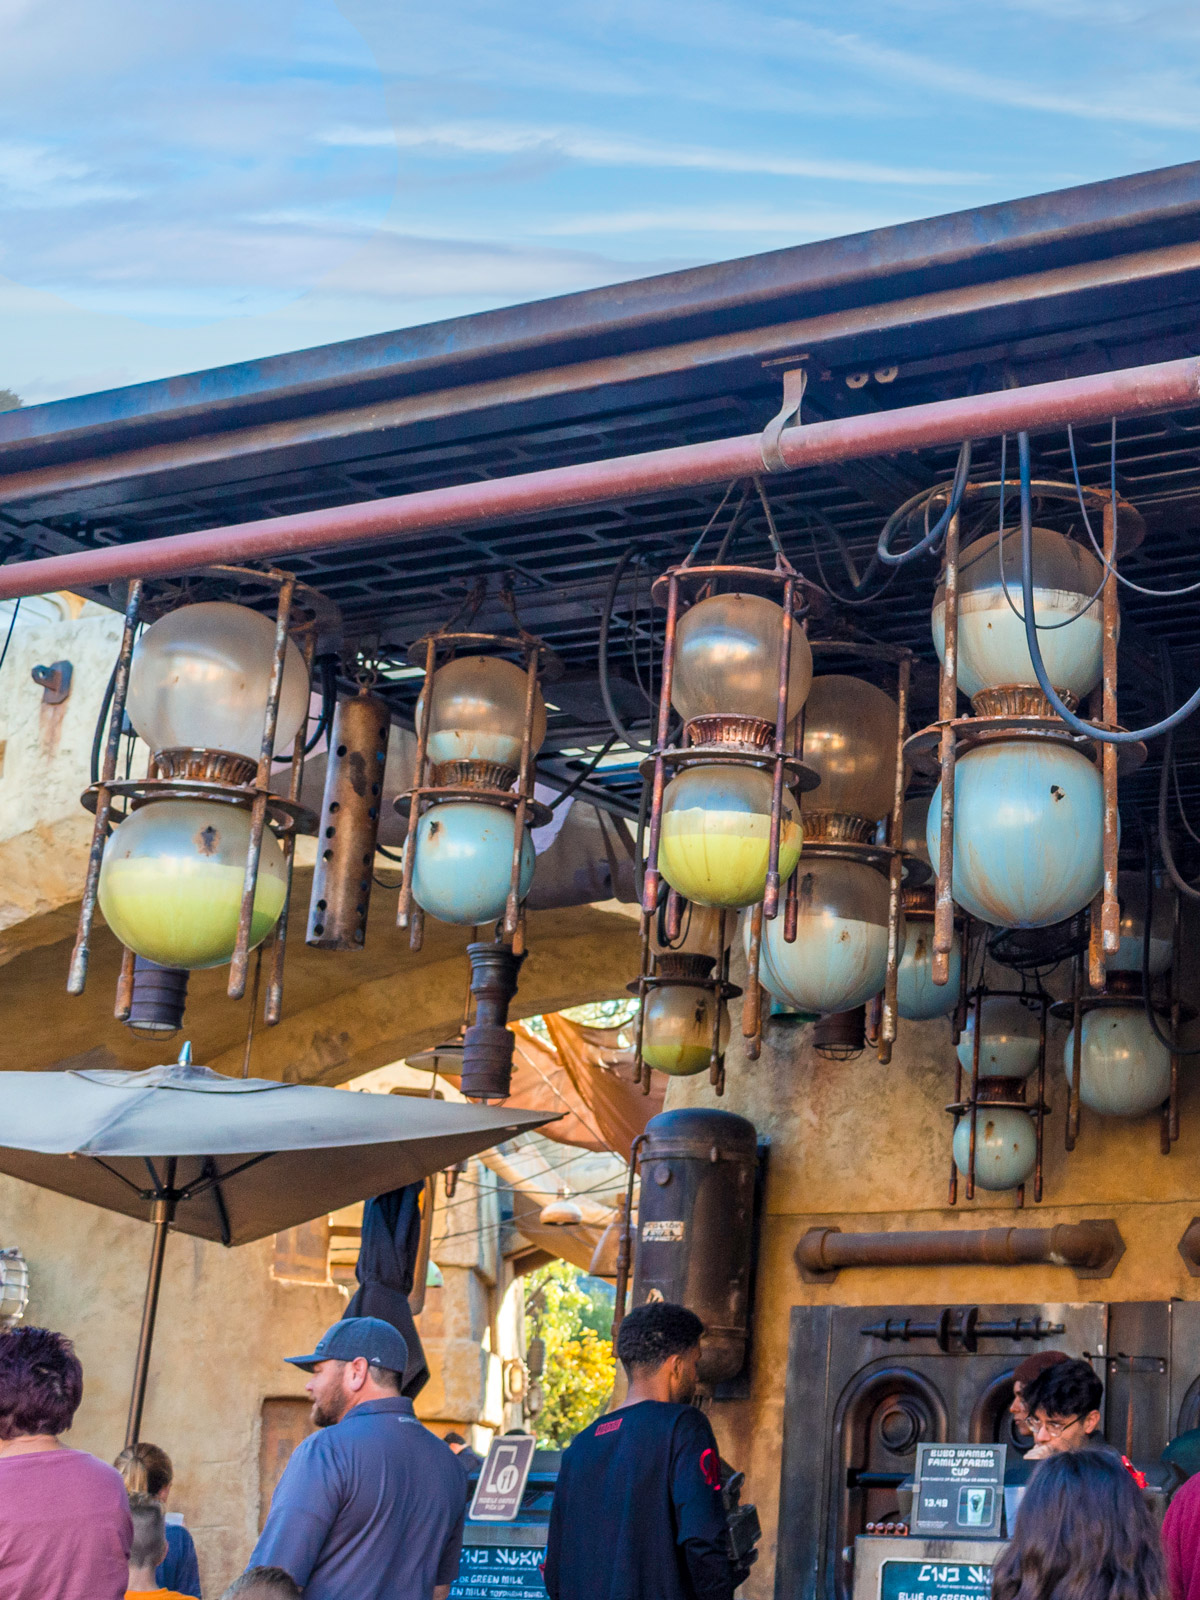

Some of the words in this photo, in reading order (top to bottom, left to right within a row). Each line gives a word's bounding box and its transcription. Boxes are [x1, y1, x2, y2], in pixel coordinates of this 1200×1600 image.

[930, 1449, 956, 1458] BUBO
[956, 1449, 994, 1458] WAMBA
[927, 1458, 962, 1467] FAMILY
[962, 1458, 995, 1468] FARMS
[951, 1467, 970, 1476] CUP
[470, 1574, 500, 1584] GREEN
[501, 1575, 524, 1585] MILK
[465, 1587, 488, 1596] MILK
[898, 1591, 925, 1600] BLUE
